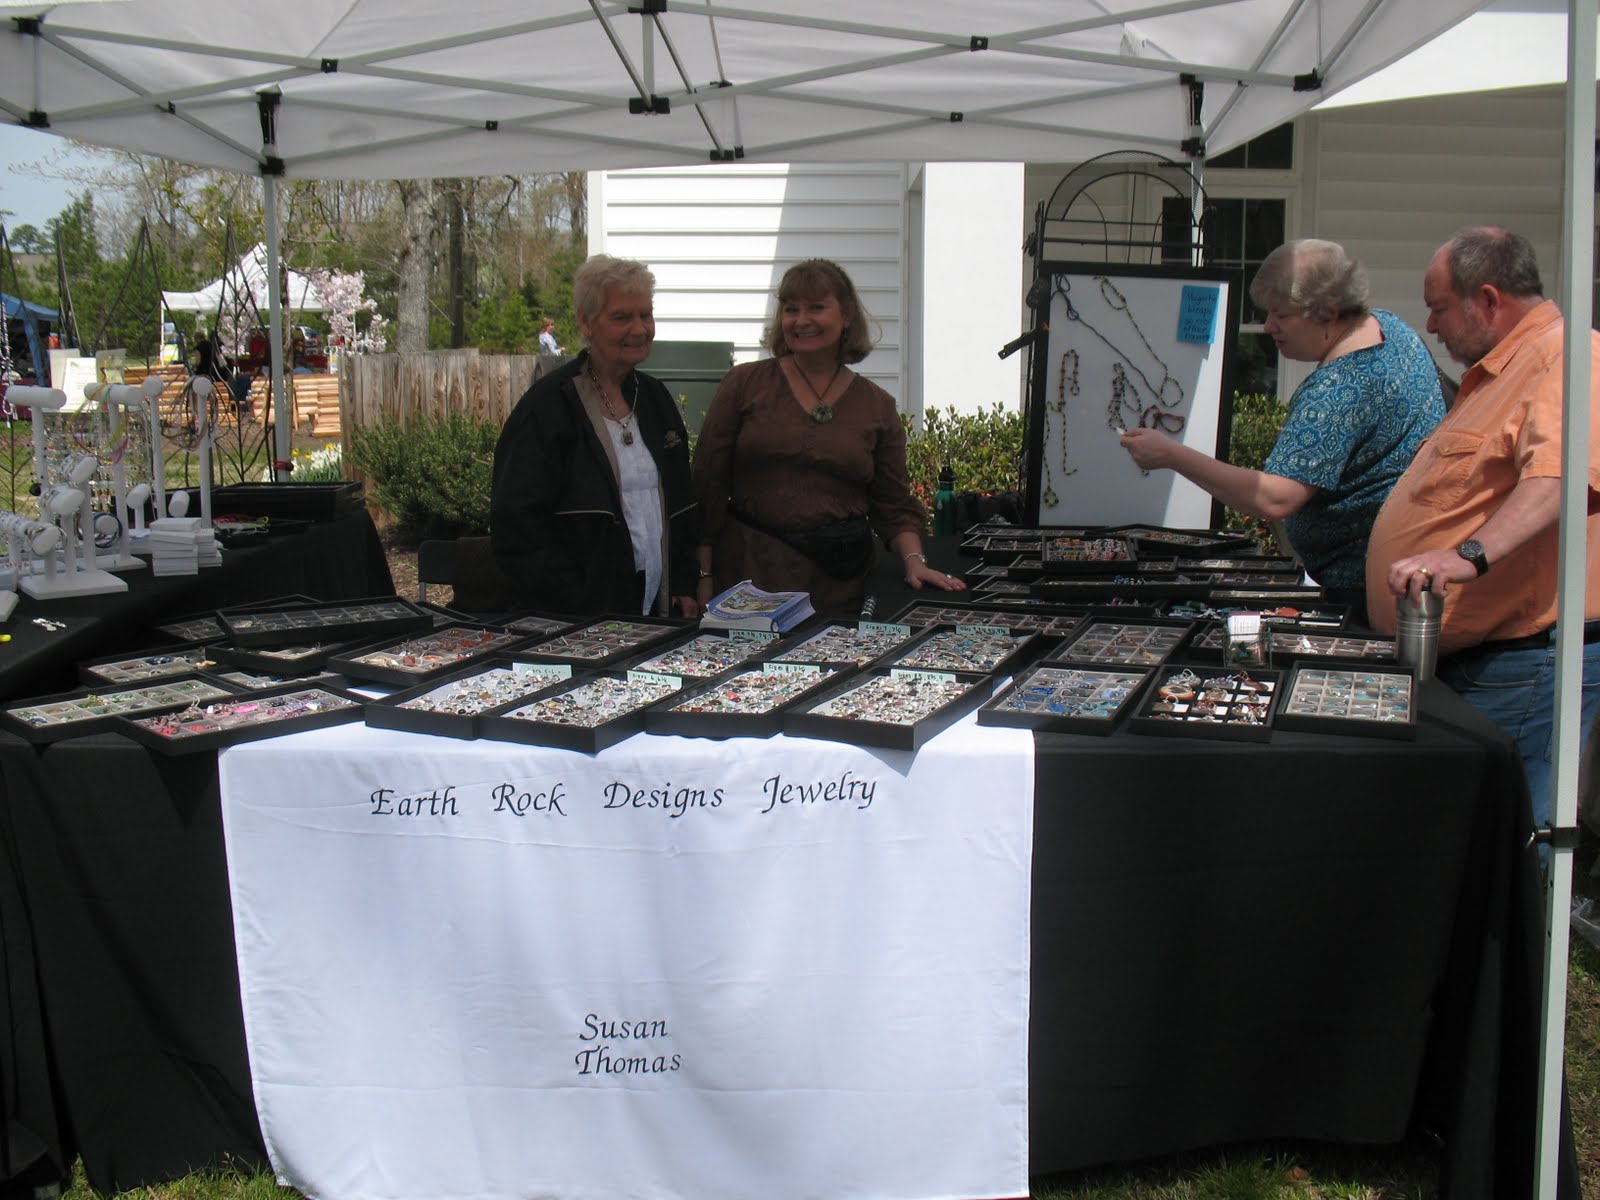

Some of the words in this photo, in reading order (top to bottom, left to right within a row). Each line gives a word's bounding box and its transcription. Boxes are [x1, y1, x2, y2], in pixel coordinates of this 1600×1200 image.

[370, 786, 459, 816] Earth
[491, 782, 567, 817] Rock
[603, 781, 724, 818] Designs
[761, 770, 877, 814] Jewelry
[579, 1013, 668, 1041] Susan
[575, 1045, 681, 1075] Thomas
